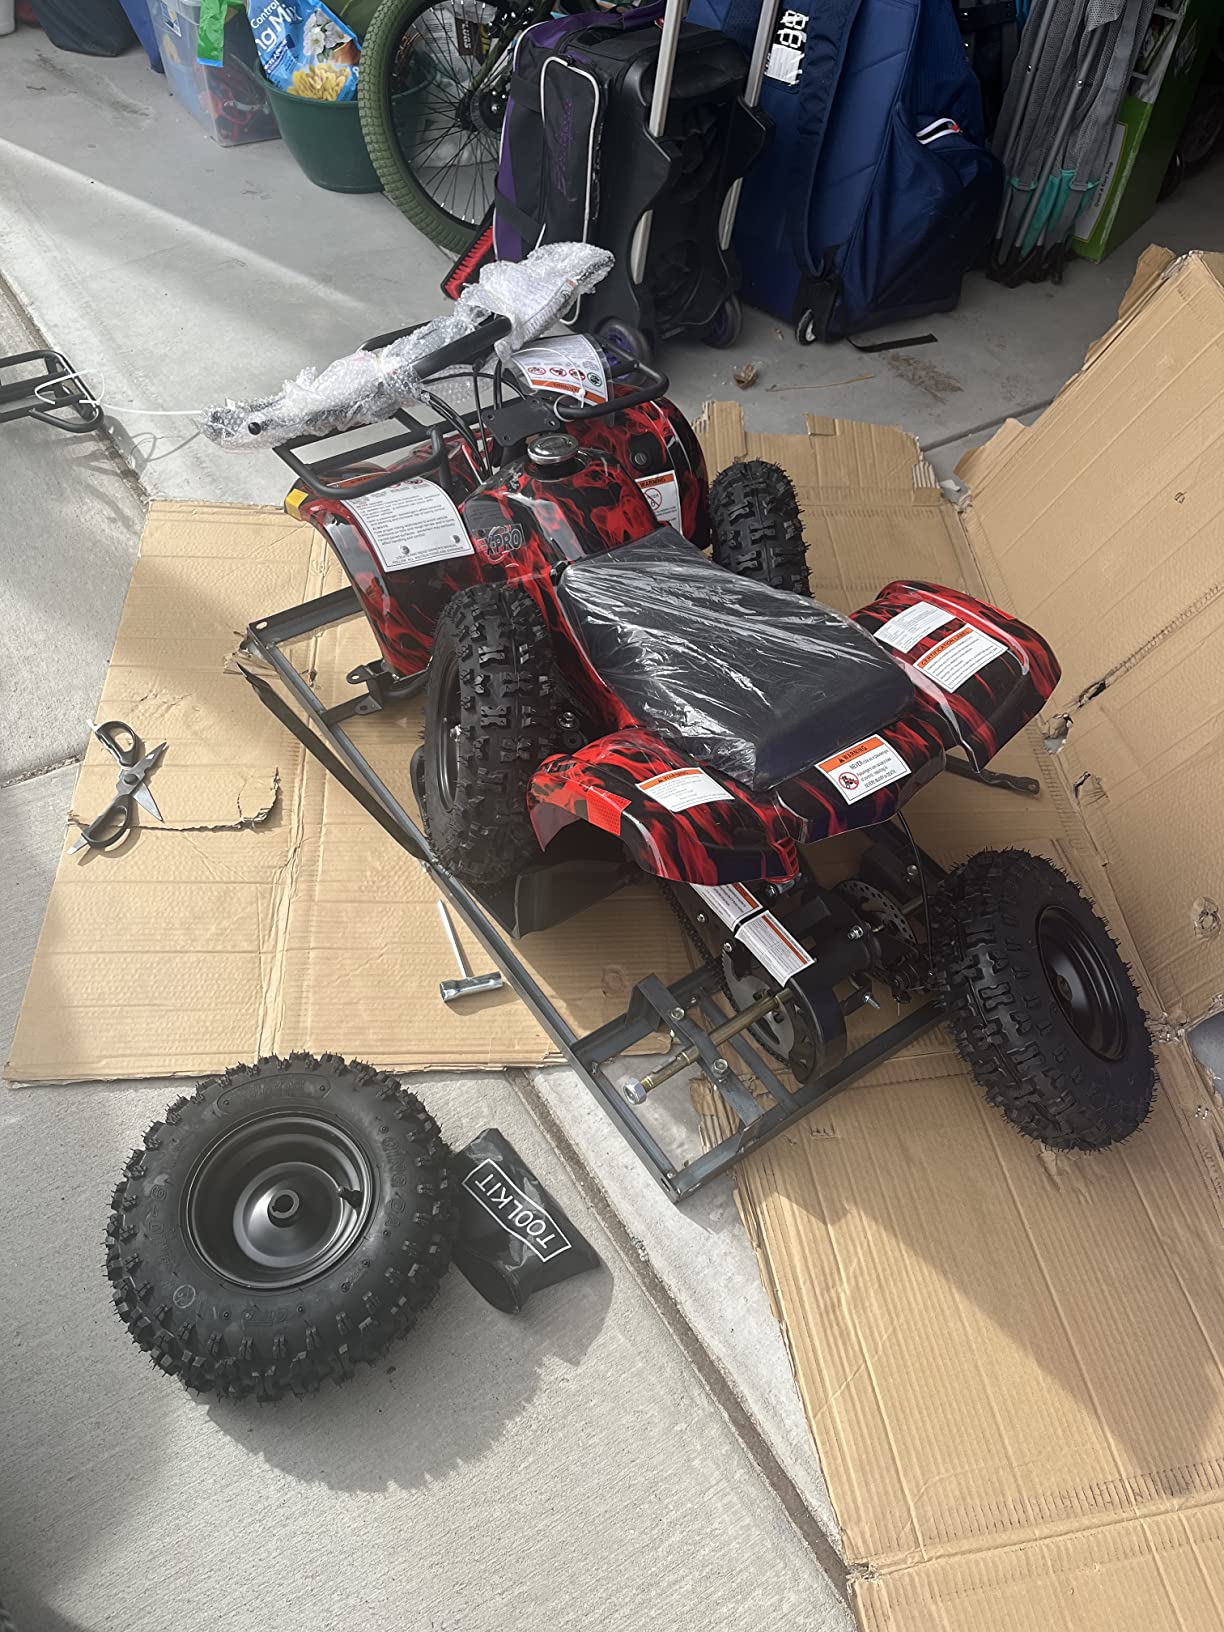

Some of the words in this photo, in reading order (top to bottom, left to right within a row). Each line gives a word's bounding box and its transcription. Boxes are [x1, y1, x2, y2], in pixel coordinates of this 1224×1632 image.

[250, 0, 281, 29] Control
[268, 4, 303, 33] Mix
[844, 746, 868, 760] WARNING
[474, 1173, 555, 1249] TOOLKIT
